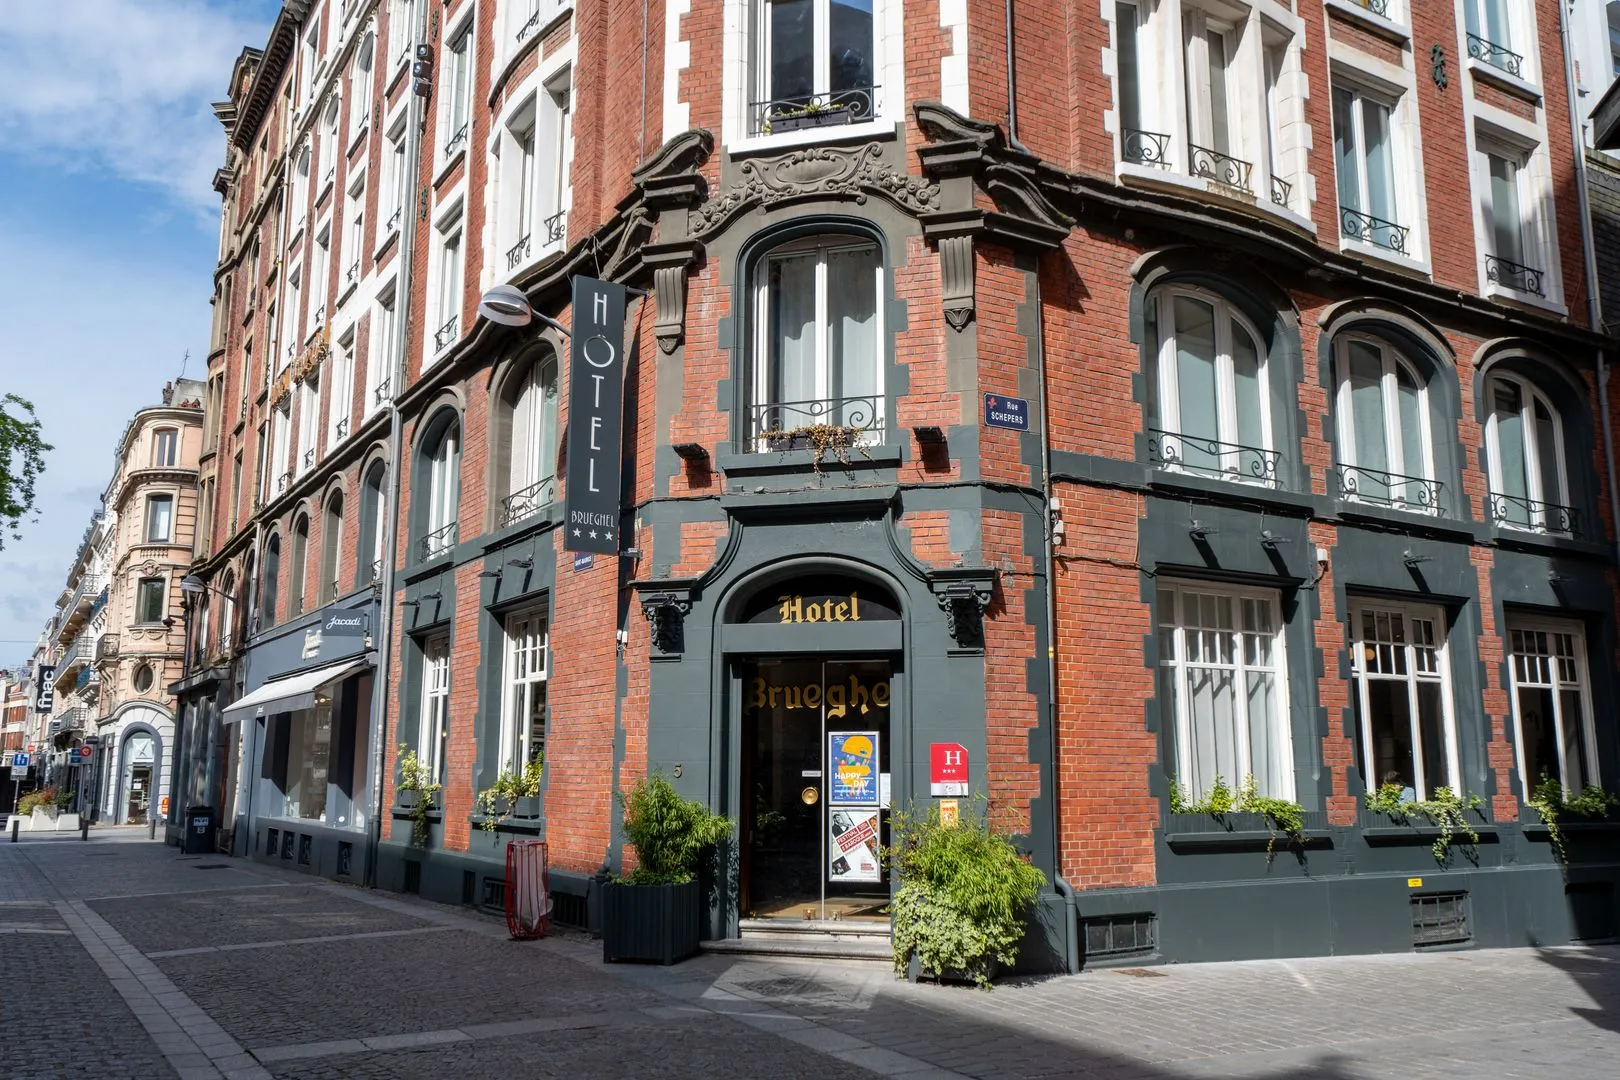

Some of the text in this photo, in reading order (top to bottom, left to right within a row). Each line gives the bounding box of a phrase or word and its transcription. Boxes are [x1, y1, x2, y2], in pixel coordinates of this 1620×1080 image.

[1006, 401, 1019, 411] Rue
[991, 411, 1024, 425] SCHEPERS
[571, 510, 615, 528] BRUEGHEL
[778, 592, 861, 624] Hotel
[325, 615, 361, 630] jacadi
[37, 670, 54, 709] fnac
[944, 750, 962, 766] H
[673, 764, 683, 779] 5
[834, 772, 861, 780] HAPPY
[853, 780, 870, 788] DAY
[837, 829, 859, 846] FESTIVAL
